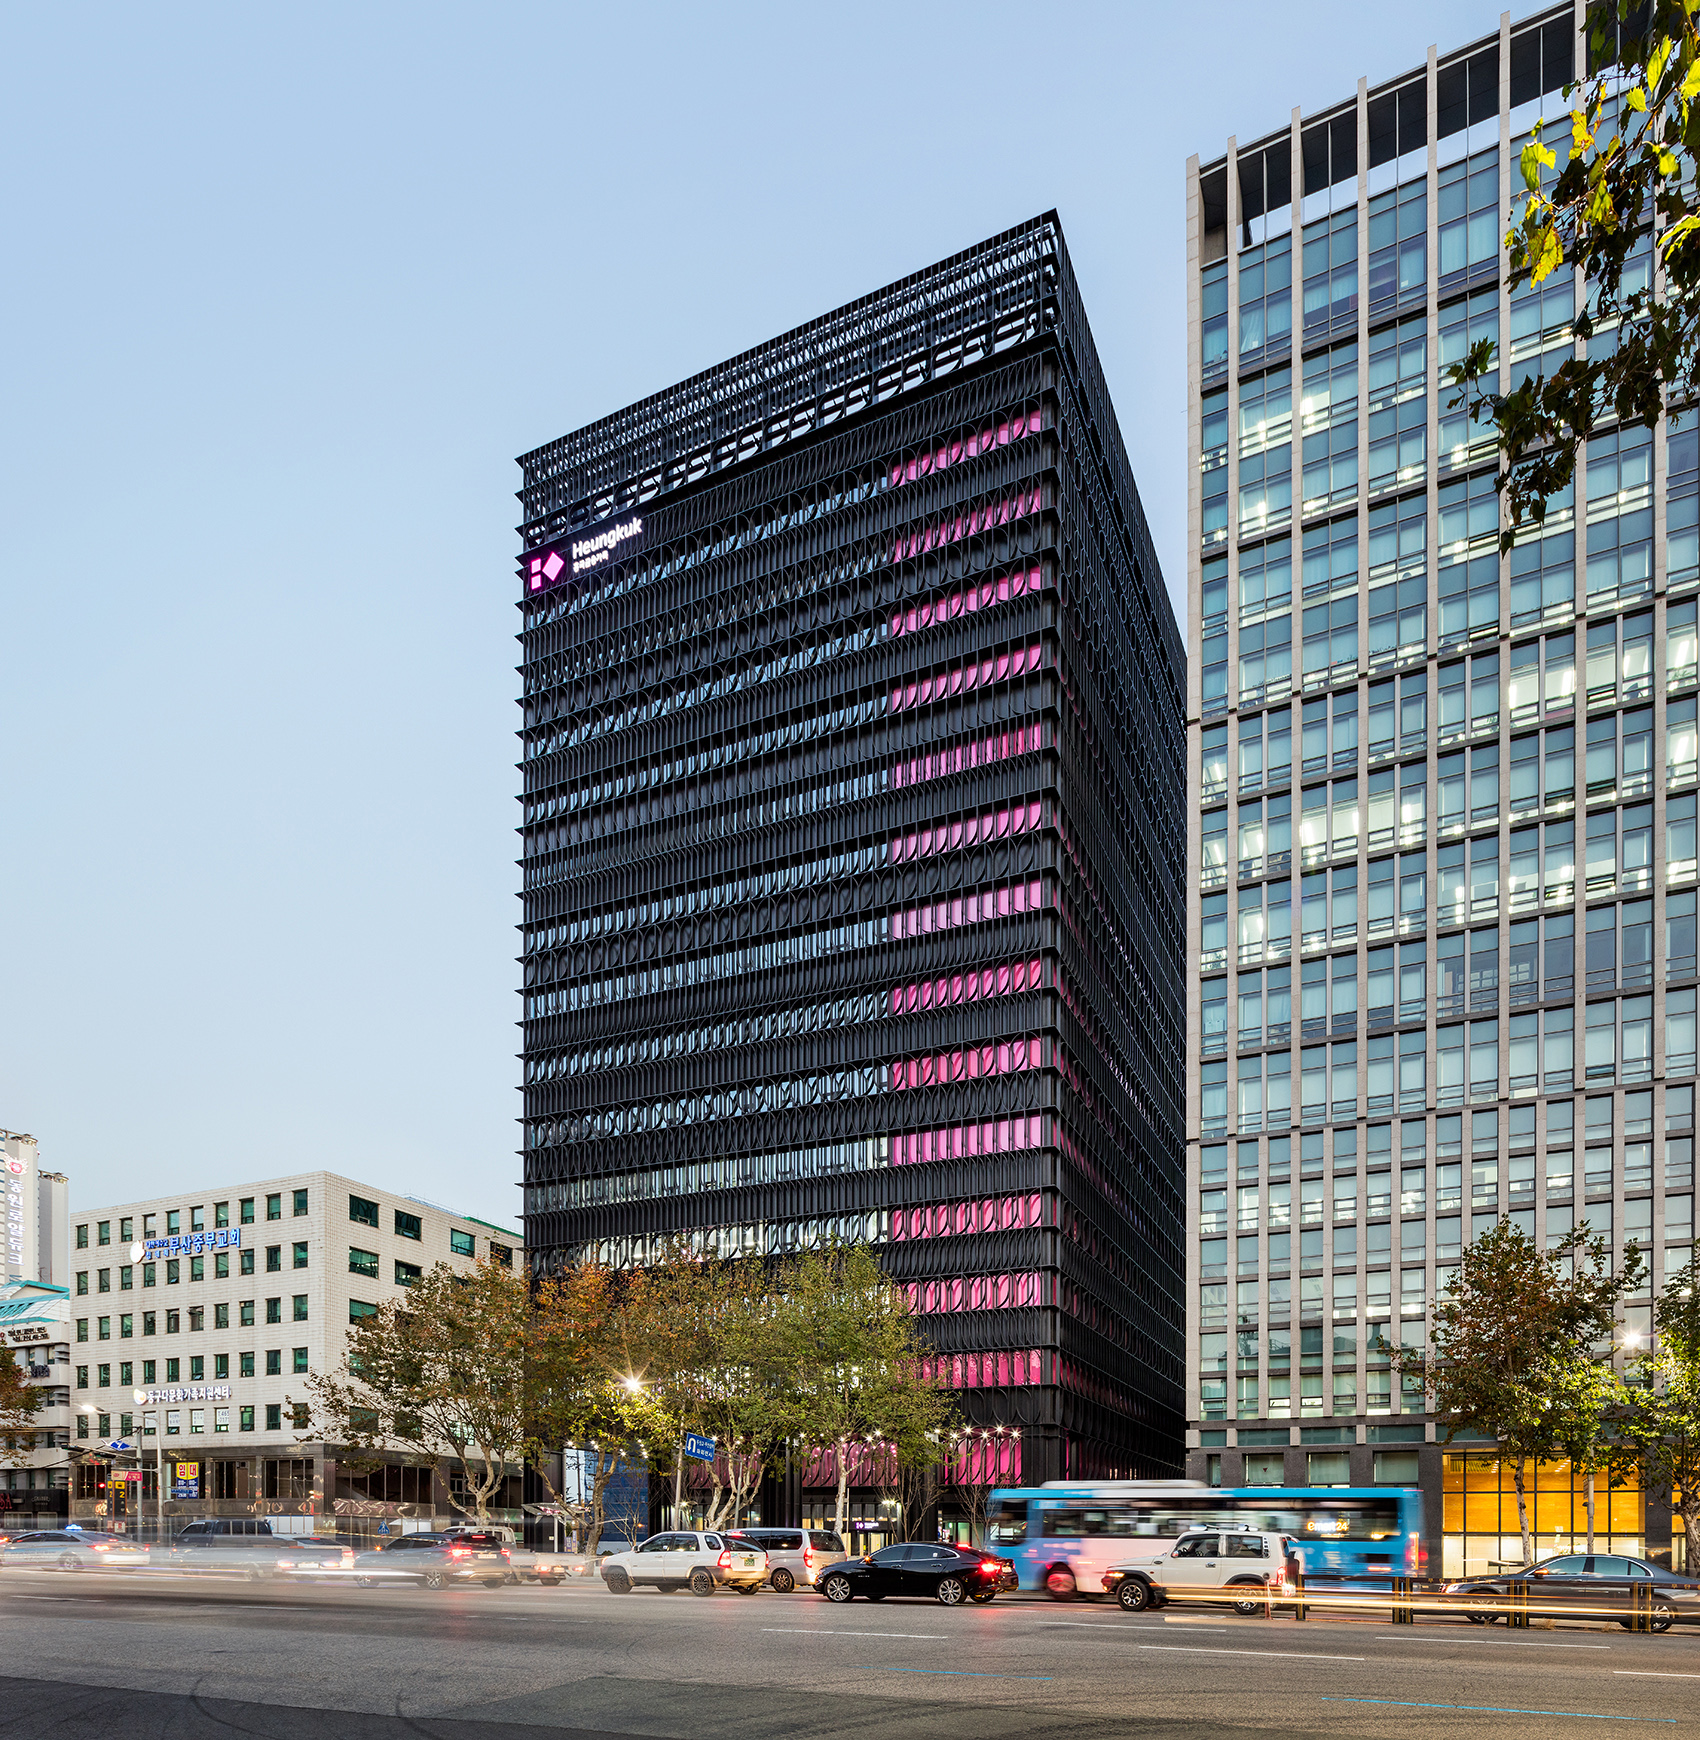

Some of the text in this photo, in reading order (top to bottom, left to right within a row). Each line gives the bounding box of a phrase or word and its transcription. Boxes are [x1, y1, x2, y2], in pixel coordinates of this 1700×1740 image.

[572, 516, 643, 560] Heungkuk
[7, 1178, 25, 1266] 동원로얄듀크
[169, 1227, 241, 1256] 부산중부교회
[147, 1385, 231, 1404] 동구다문화가족지원센터
[178, 1464, 197, 1477] 임대
